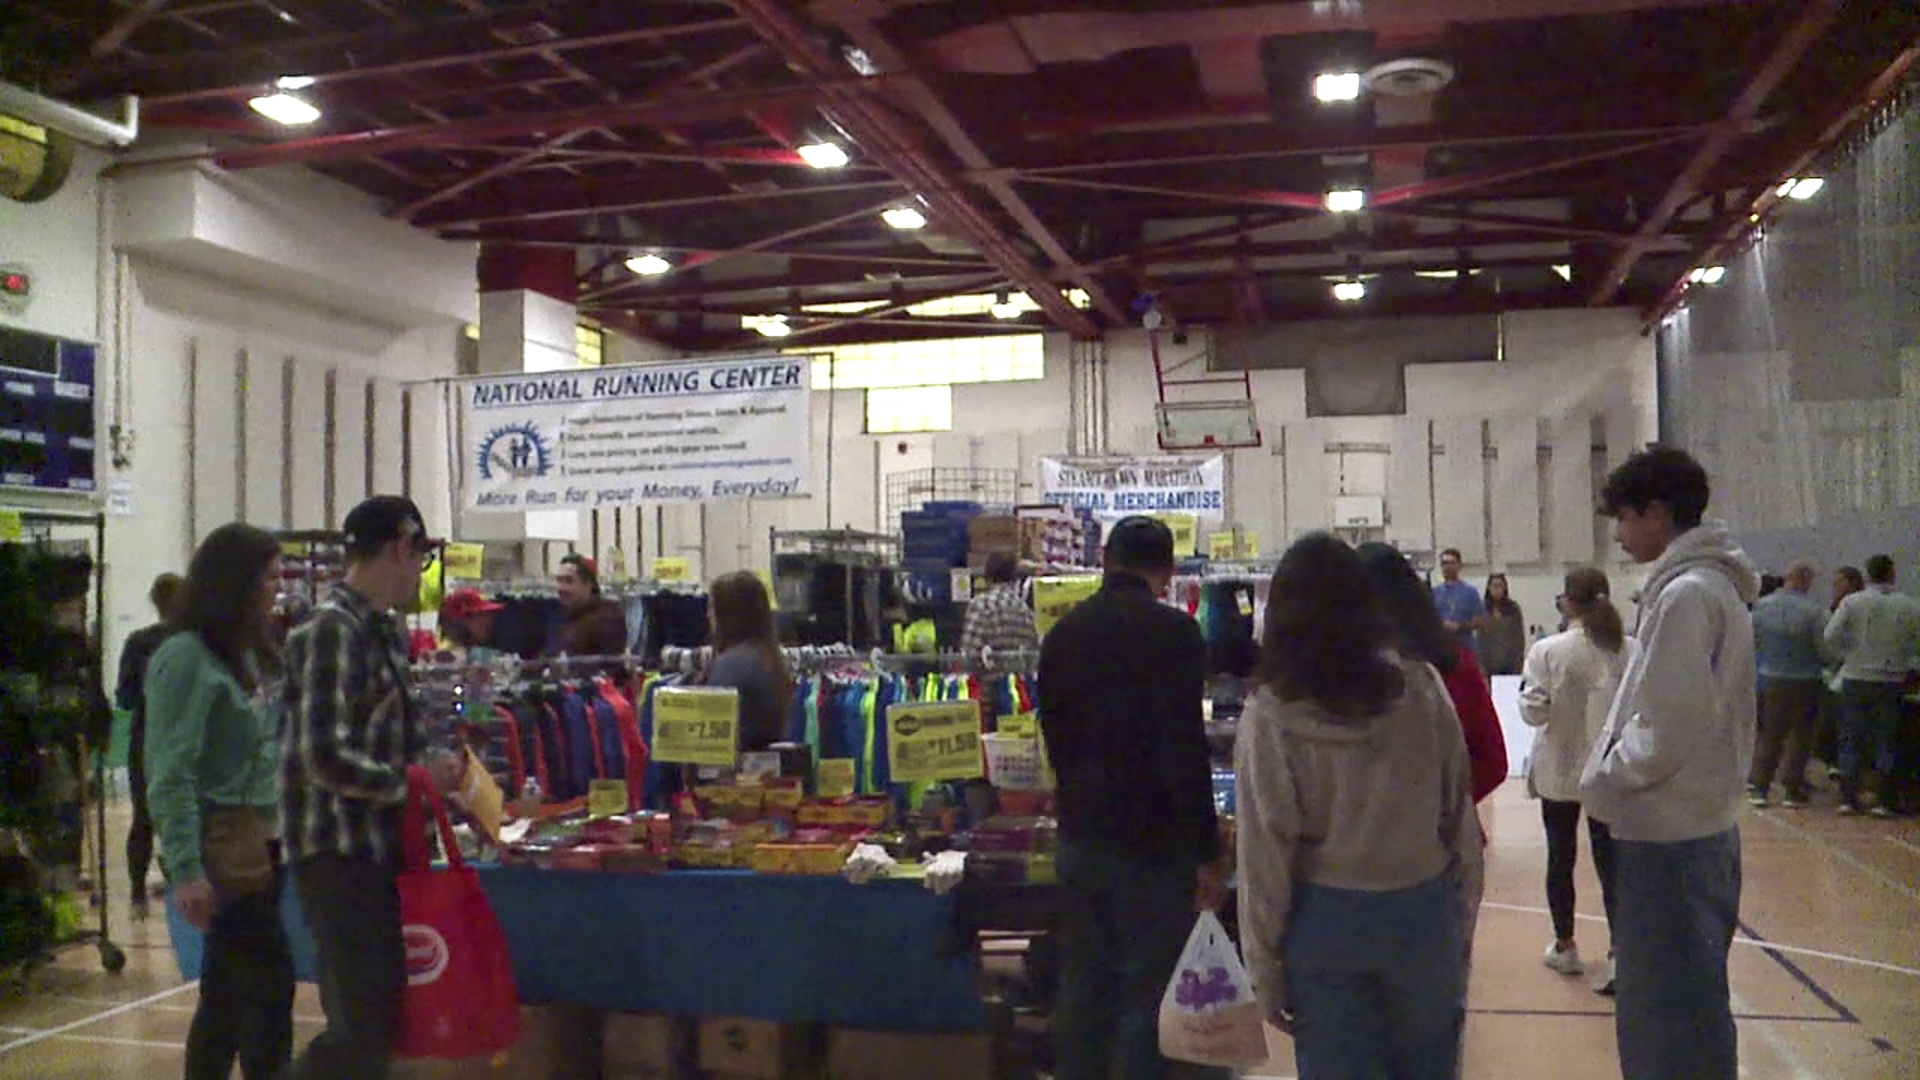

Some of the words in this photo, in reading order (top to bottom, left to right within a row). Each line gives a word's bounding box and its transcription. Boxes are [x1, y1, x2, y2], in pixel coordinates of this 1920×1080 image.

[473, 379, 582, 404] NATIONAL
[592, 370, 699, 397] RUNNING
[710, 364, 801, 390] CENTER
[476, 492, 518, 505] More
[526, 489, 558, 504] Run
[565, 487, 589, 502] for
[595, 487, 634, 504] your
[712, 477, 799, 498] Everyday!
[1114, 490, 1221, 511] MERCHANDISE
